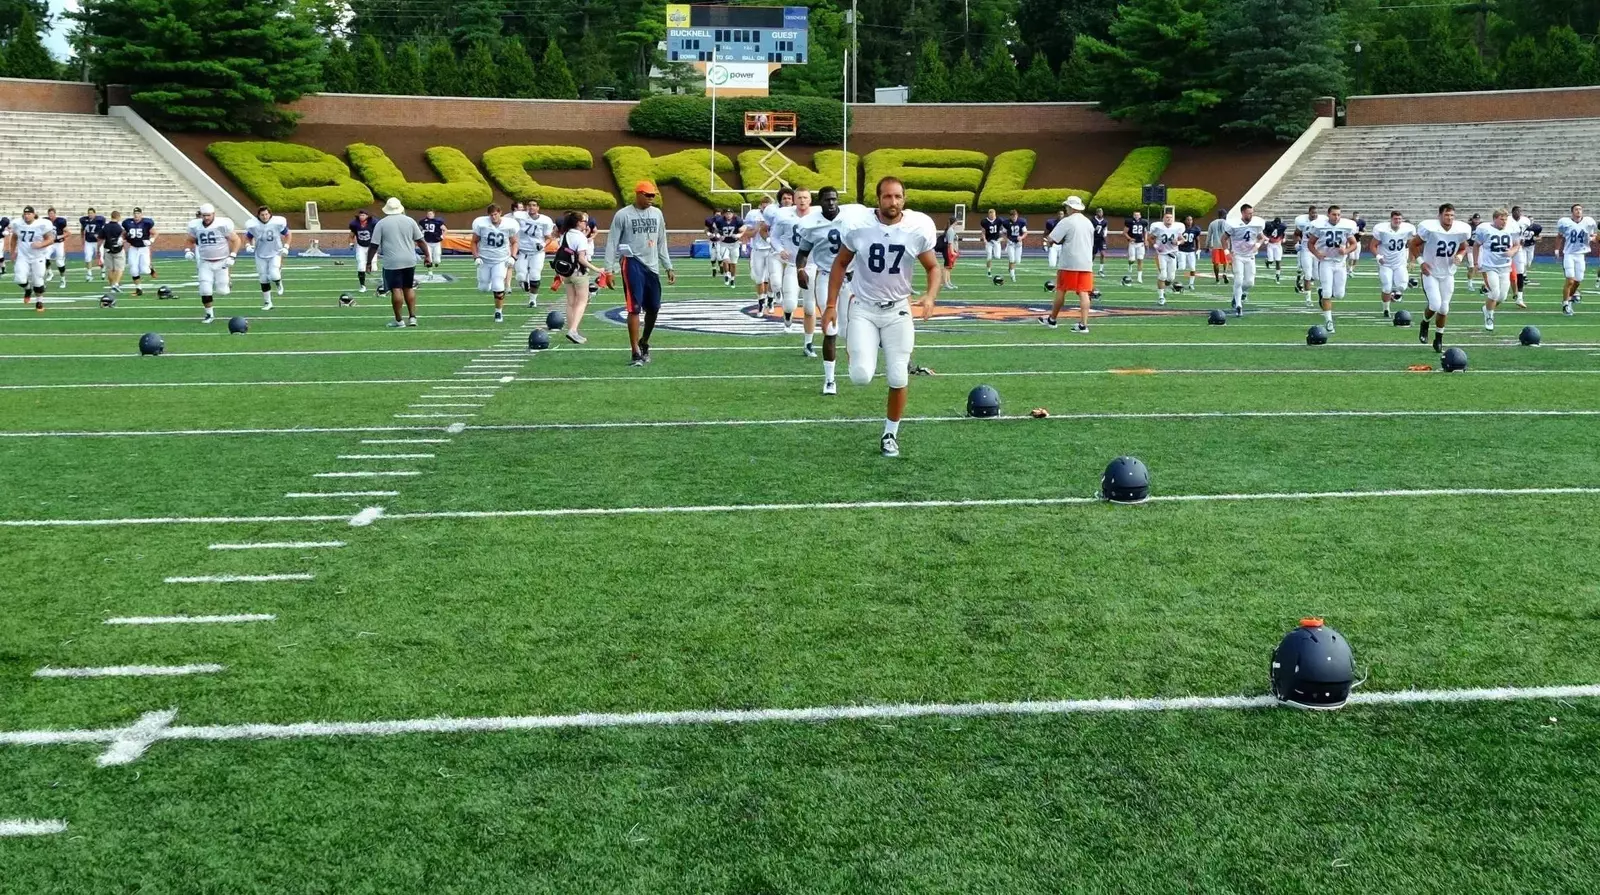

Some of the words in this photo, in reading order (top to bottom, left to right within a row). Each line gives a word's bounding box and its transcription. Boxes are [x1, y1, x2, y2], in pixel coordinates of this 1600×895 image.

[670, 30, 712, 38] BUCKNELL
[771, 31, 798, 39] GUEST
[207, 141, 1217, 216] BUCKNELL
[631, 218, 657, 227] BISON
[129, 228, 143, 239] 95
[525, 223, 538, 237] 71
[632, 226, 657, 234] POWER
[722, 226, 735, 237] 27
[1011, 226, 1020, 237] 12
[1132, 225, 1144, 234] 22
[20, 230, 35, 242] 77
[199, 231, 217, 244] 66
[487, 232, 504, 248] 63
[1243, 230, 1250, 242] 4
[1325, 230, 1342, 248] 25
[1570, 229, 1585, 243] 84
[1388, 238, 1404, 252] 33
[1436, 240, 1457, 257] 23
[868, 243, 905, 275] 87
